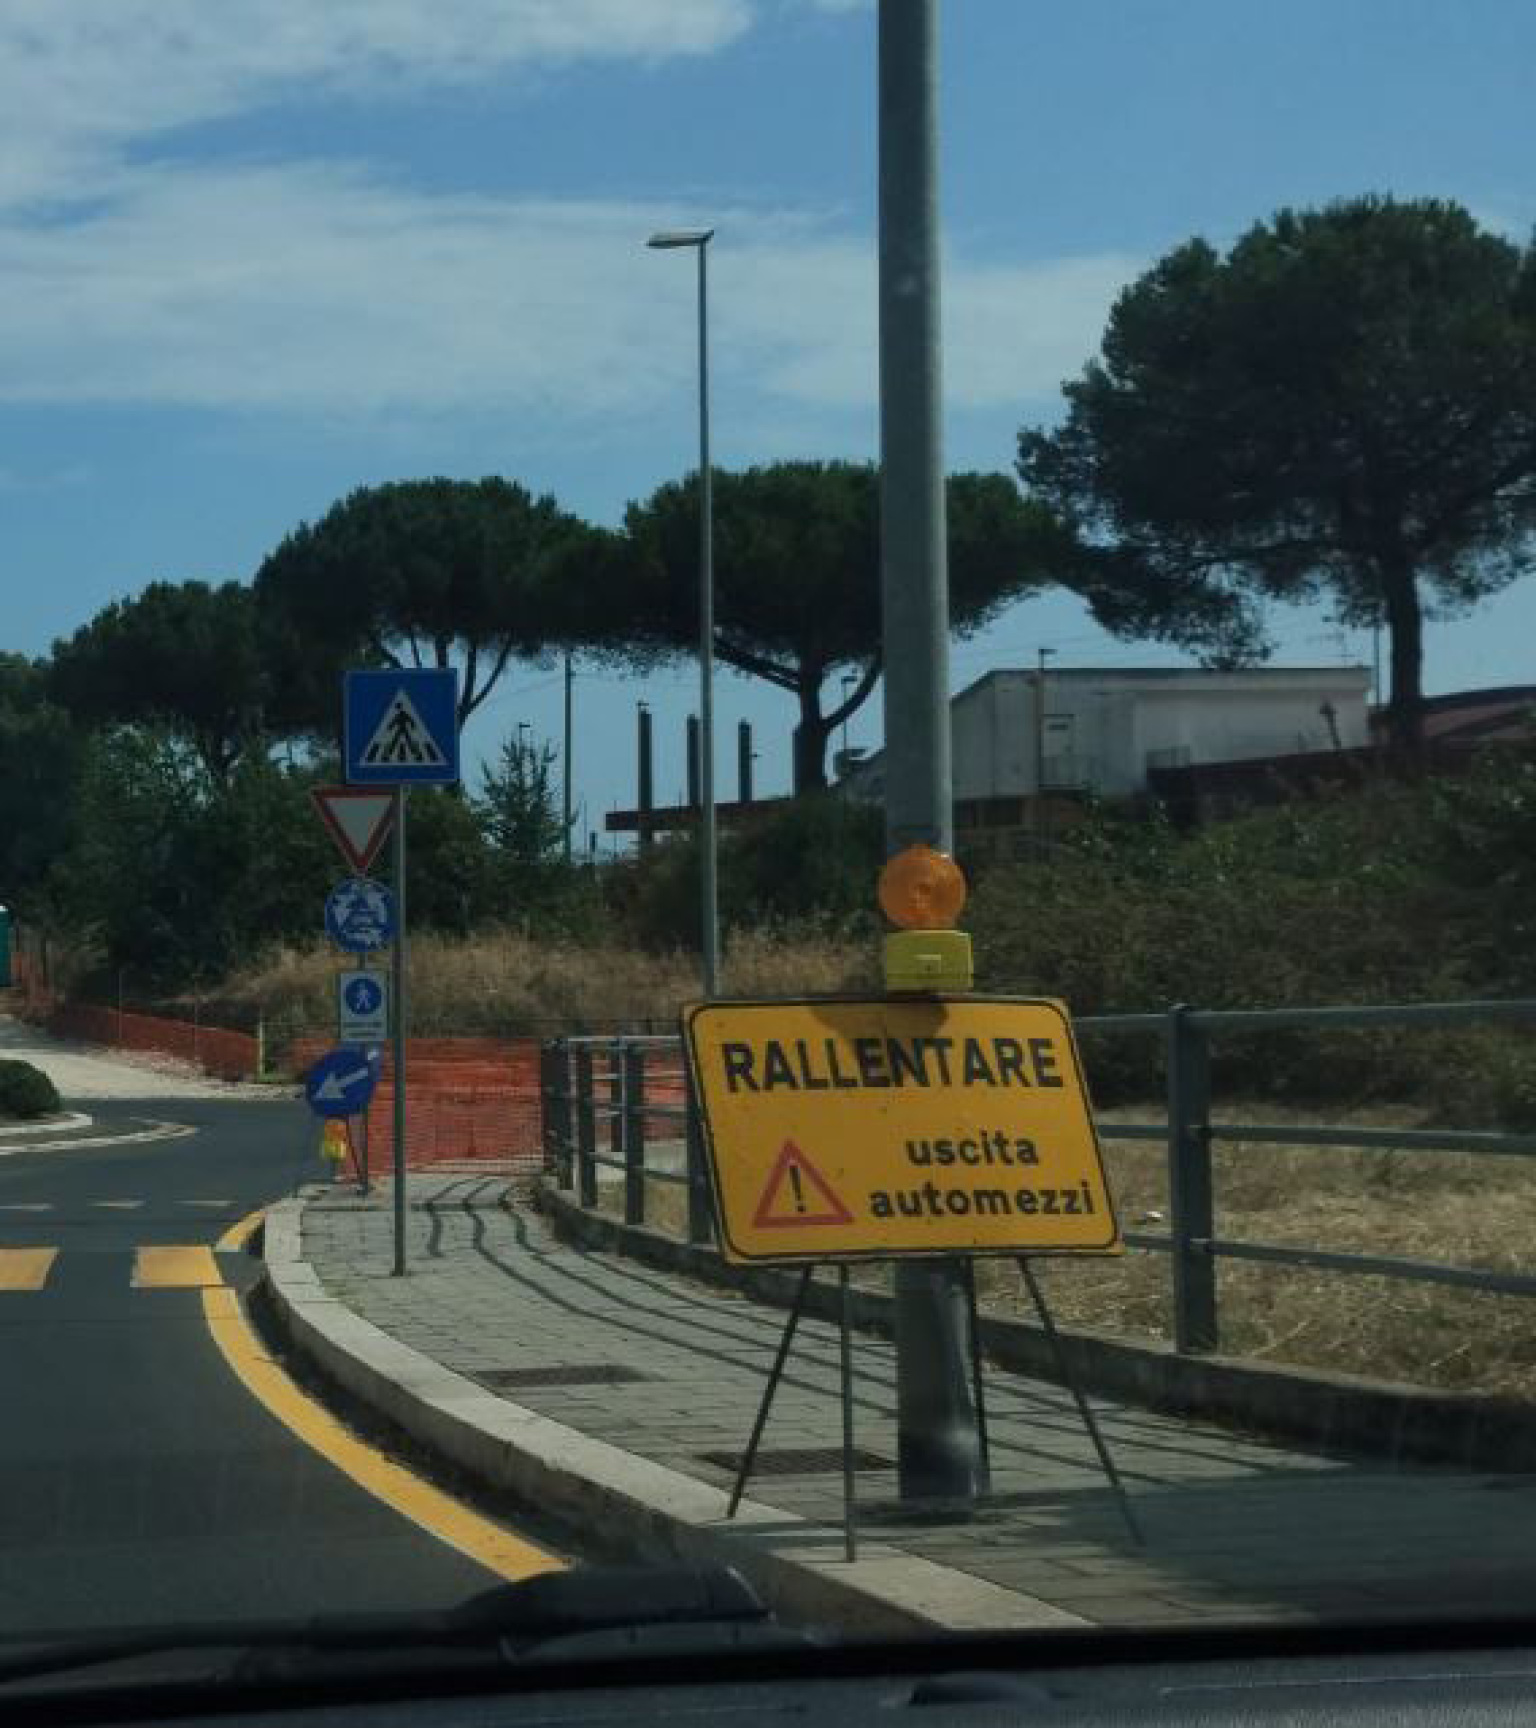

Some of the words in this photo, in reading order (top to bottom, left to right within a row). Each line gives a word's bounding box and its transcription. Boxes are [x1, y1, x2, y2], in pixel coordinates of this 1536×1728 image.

[722, 1037, 1064, 1093] RALLENTARE
[905, 1130, 1040, 1166] uscita
[869, 1181, 1095, 1218] automezzi
